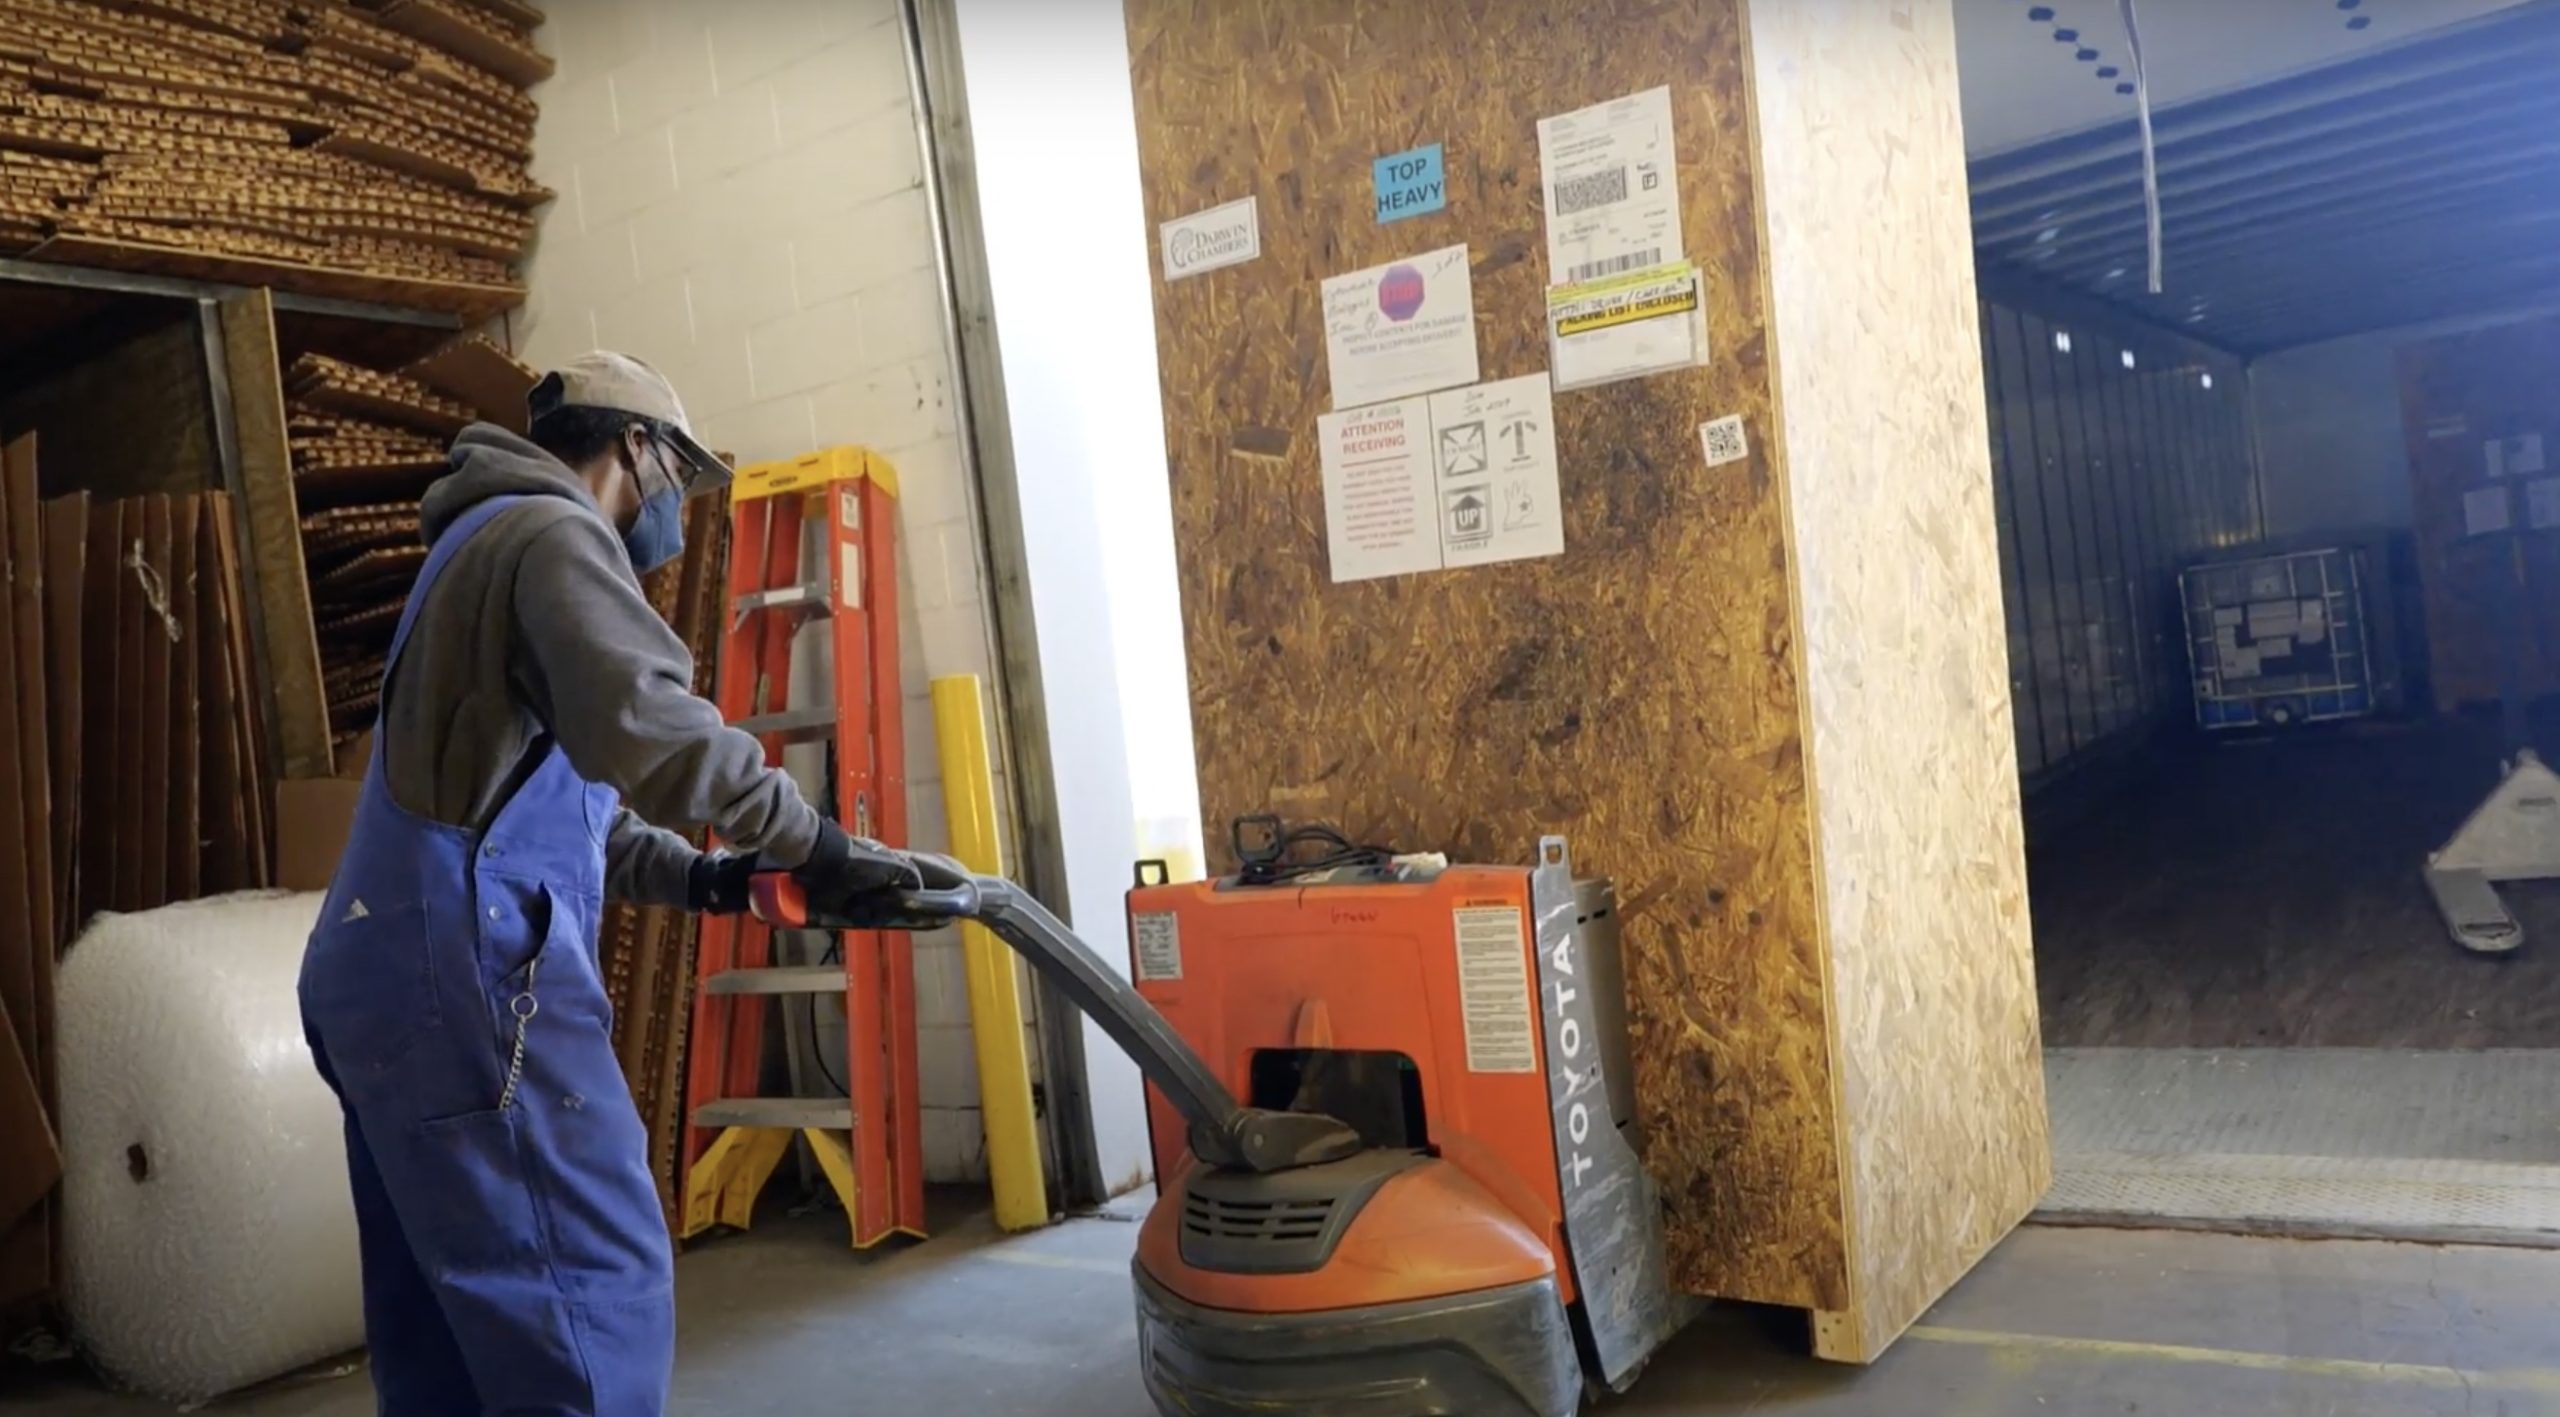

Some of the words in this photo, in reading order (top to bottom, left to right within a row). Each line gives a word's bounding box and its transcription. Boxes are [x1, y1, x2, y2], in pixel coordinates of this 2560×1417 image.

[1387, 158, 1427, 183] TOP
[1377, 180, 1442, 213] HEAVY
[1194, 222, 1248, 249] DARWIN
[1563, 309, 1607, 325] ACKING
[1341, 418, 1405, 439] ATTENTION
[1343, 434, 1406, 455] RECEIVING
[1458, 507, 1479, 526] UP
[1553, 932, 1593, 1188] TOYOTA
